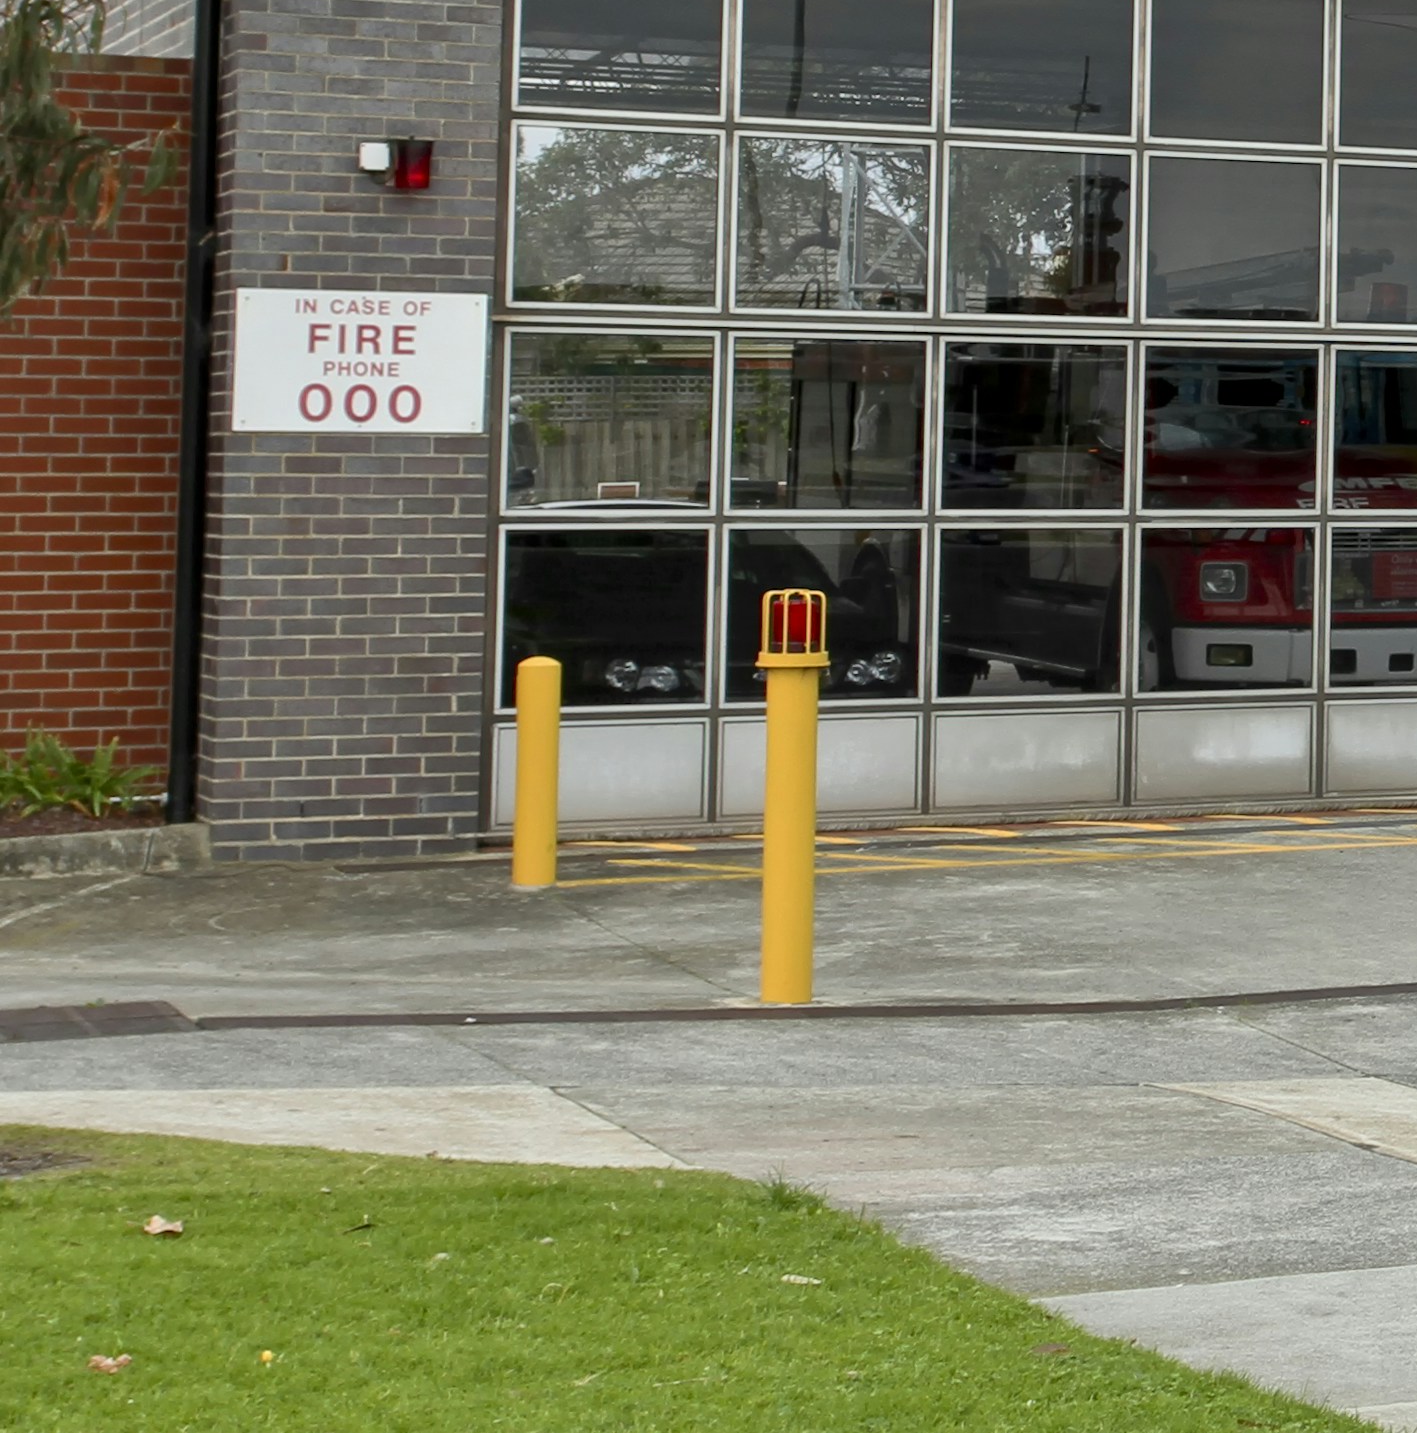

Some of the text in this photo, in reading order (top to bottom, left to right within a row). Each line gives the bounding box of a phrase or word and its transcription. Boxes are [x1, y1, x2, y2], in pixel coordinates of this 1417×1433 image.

[295, 298, 432, 316] IN CASE OF
[307, 323, 416, 355] FIRE
[323, 361, 400, 377] PHONE
[1296, 497, 1369, 509] FRE
